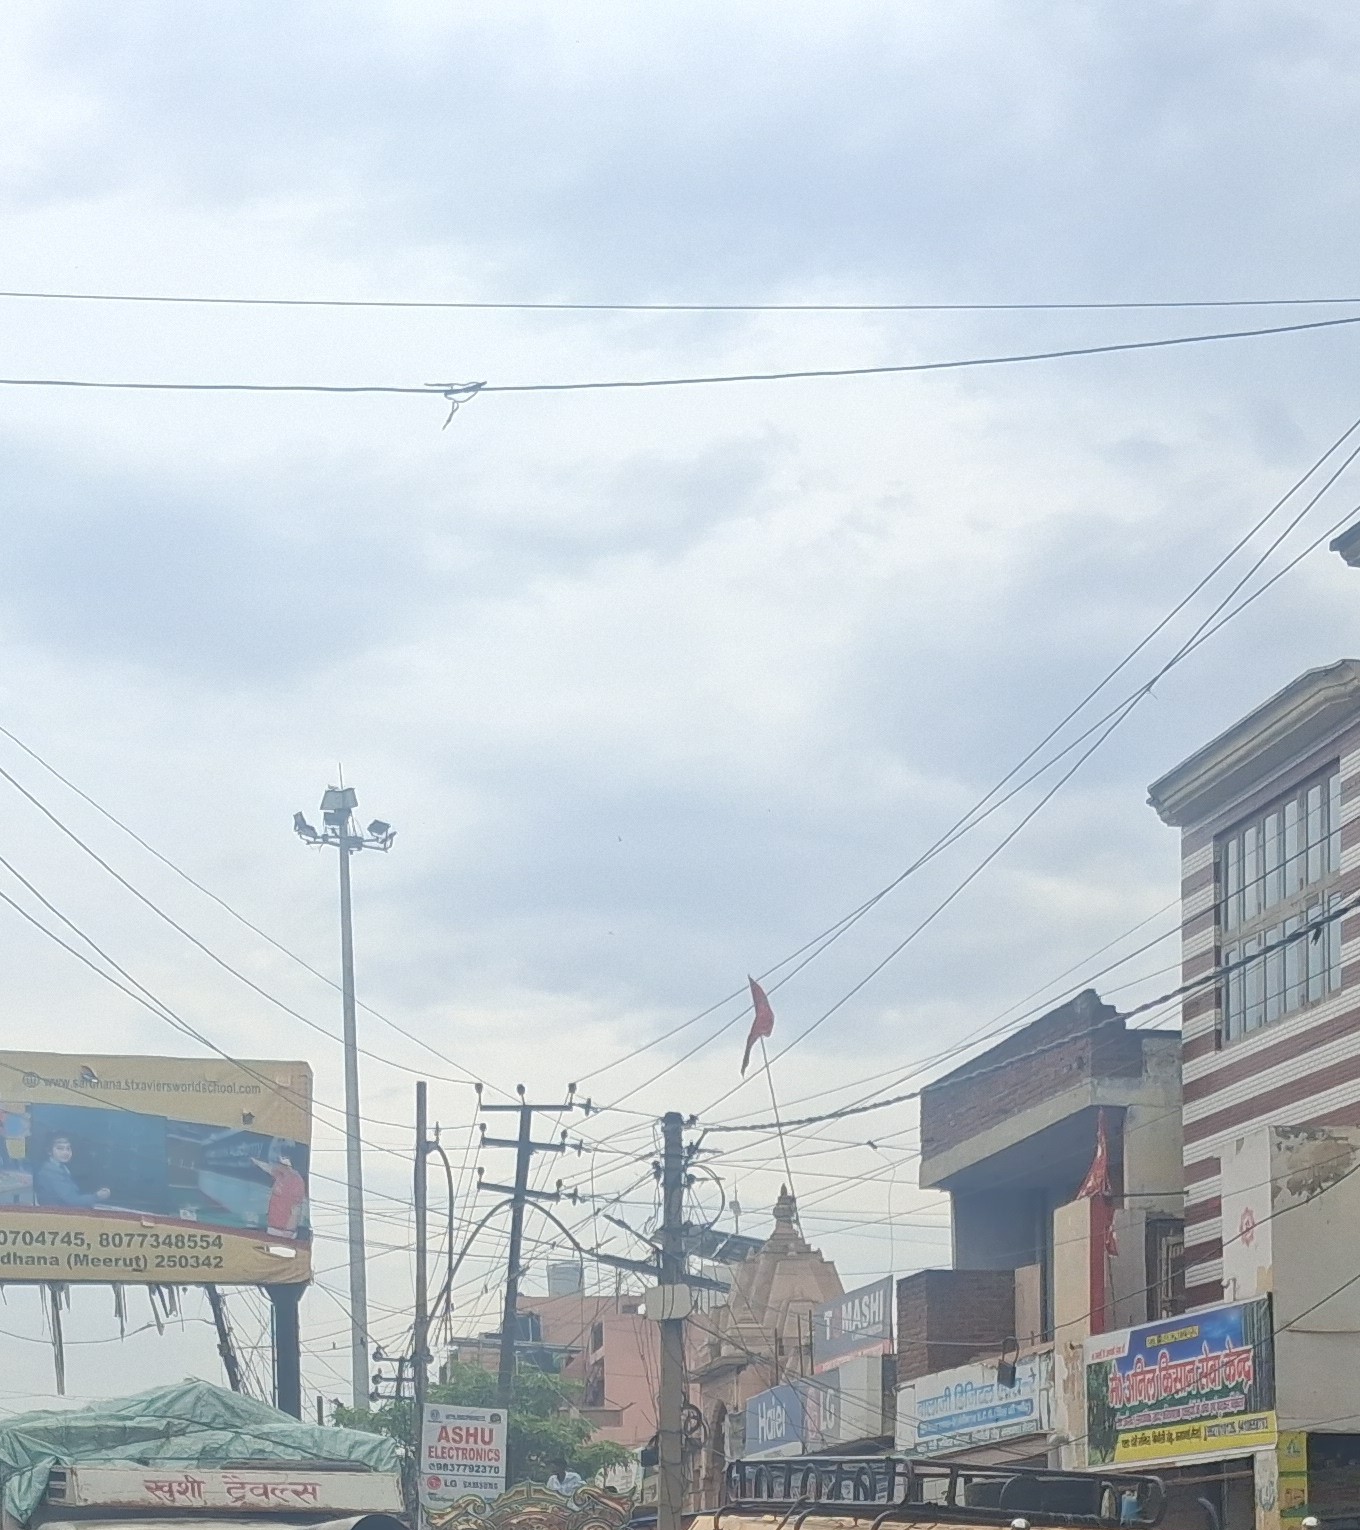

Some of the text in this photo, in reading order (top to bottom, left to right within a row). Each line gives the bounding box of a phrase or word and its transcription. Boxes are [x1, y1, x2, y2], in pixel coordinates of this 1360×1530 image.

[98, 1231, 224, 1251] 8077348554
[66, 1252, 148, 1273] (Meerut)
[154, 1253, 225, 1270] 250342
[438, 1425, 494, 1446] ASHU
[428, 1446, 500, 1463] ELECTRONICS
[443, 1480, 458, 1488] LG
